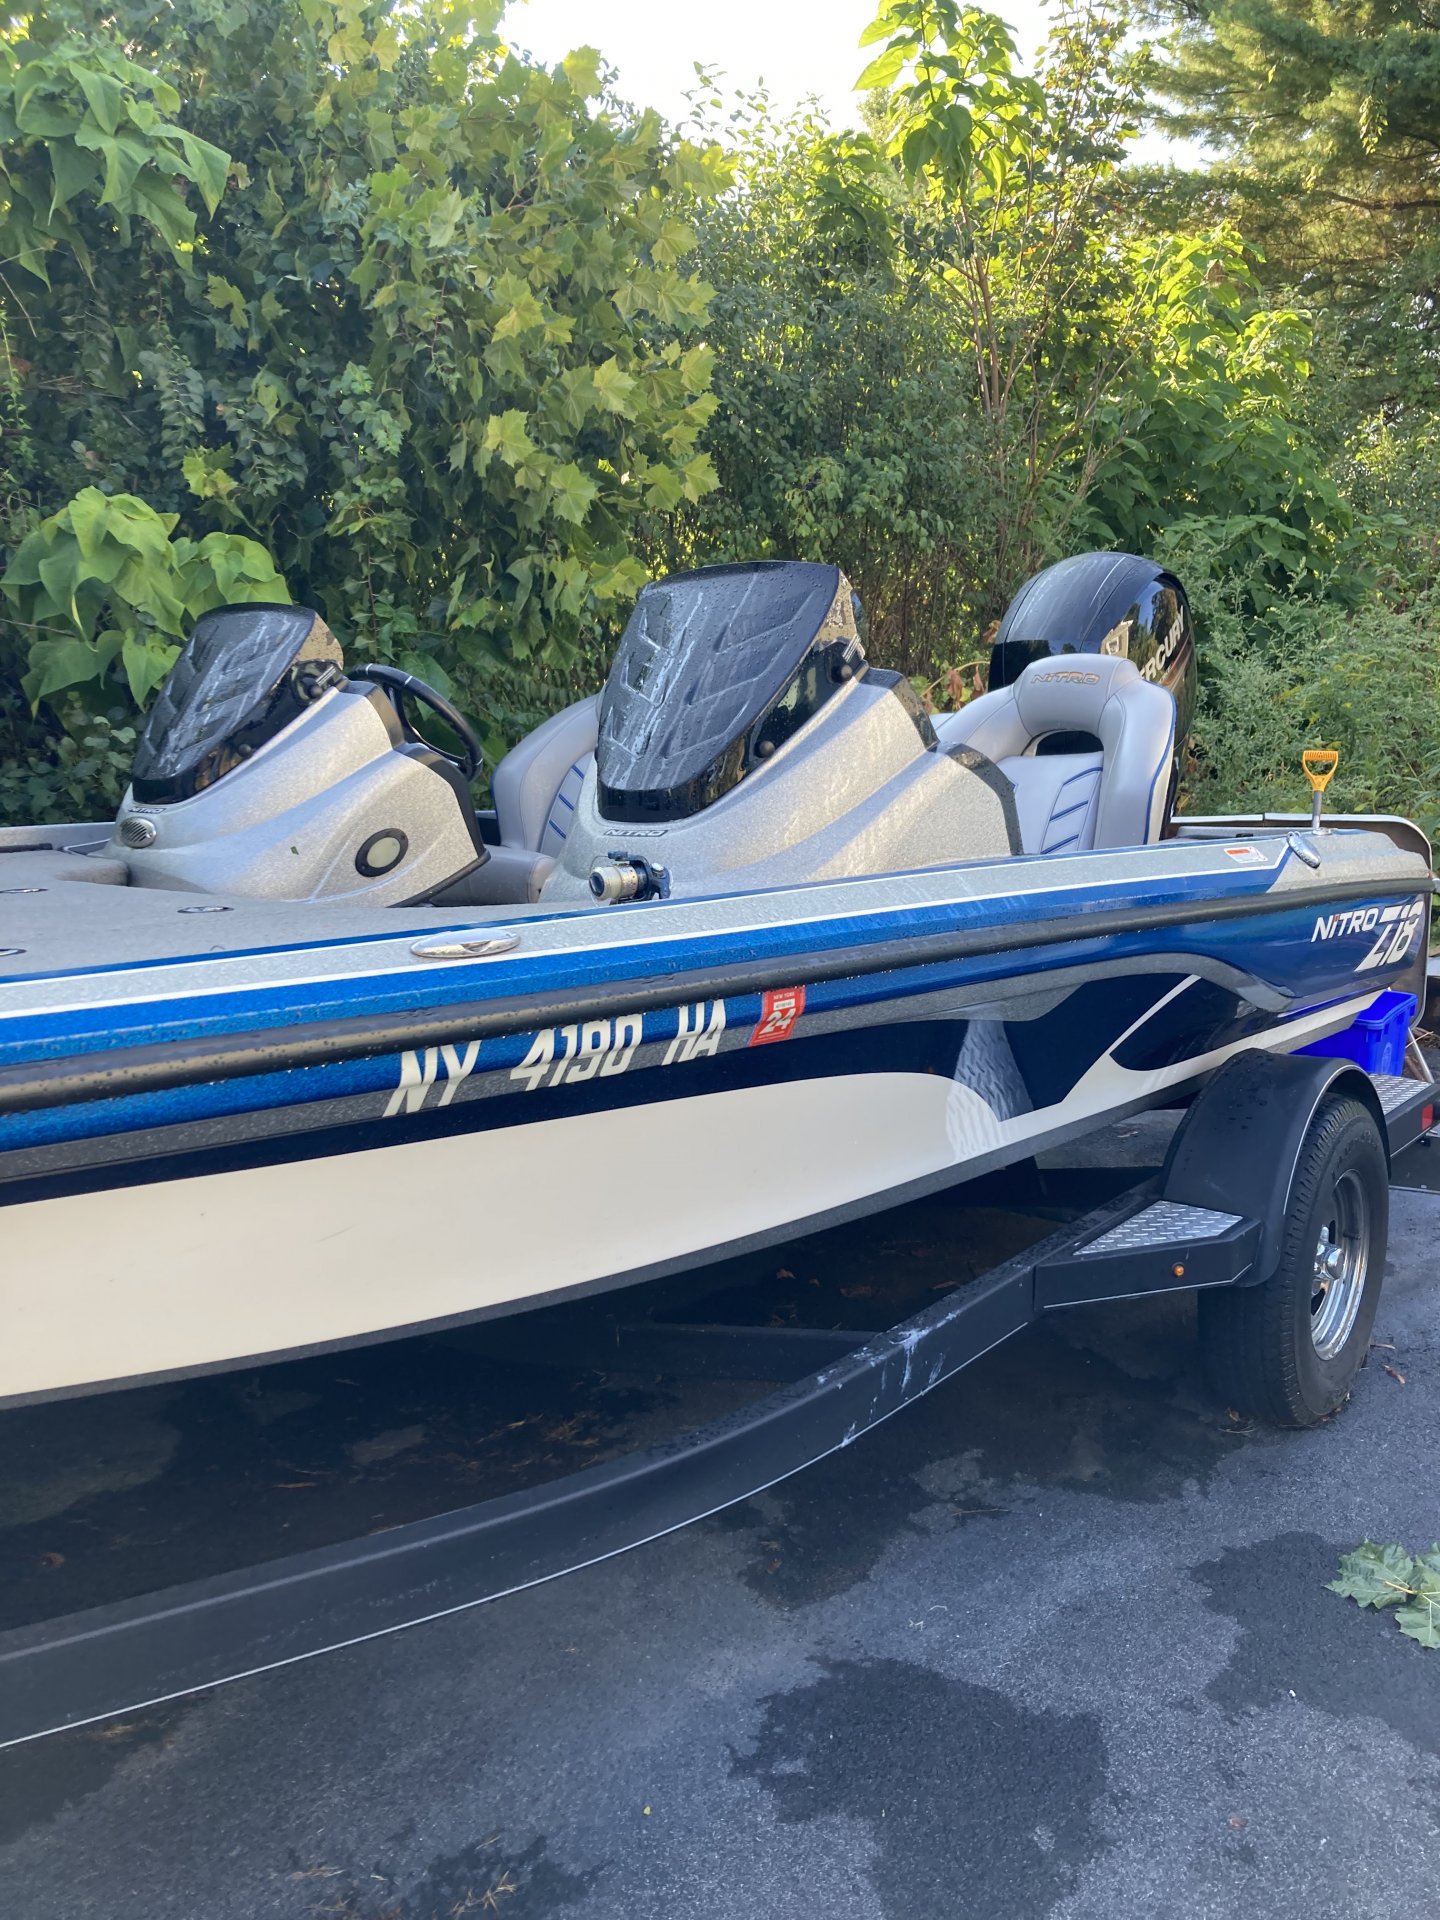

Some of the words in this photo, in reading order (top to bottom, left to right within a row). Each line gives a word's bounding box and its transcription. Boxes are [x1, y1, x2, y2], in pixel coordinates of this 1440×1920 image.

[1030, 671, 1101, 685] NITRO
[604, 829, 667, 837] NITRO
[1310, 908, 1379, 942] NITRO
[759, 1008, 796, 1034] 24
[382, 1040, 482, 1117] NY
[510, 1013, 642, 1091] 4190
[661, 999, 726, 1065] HA
